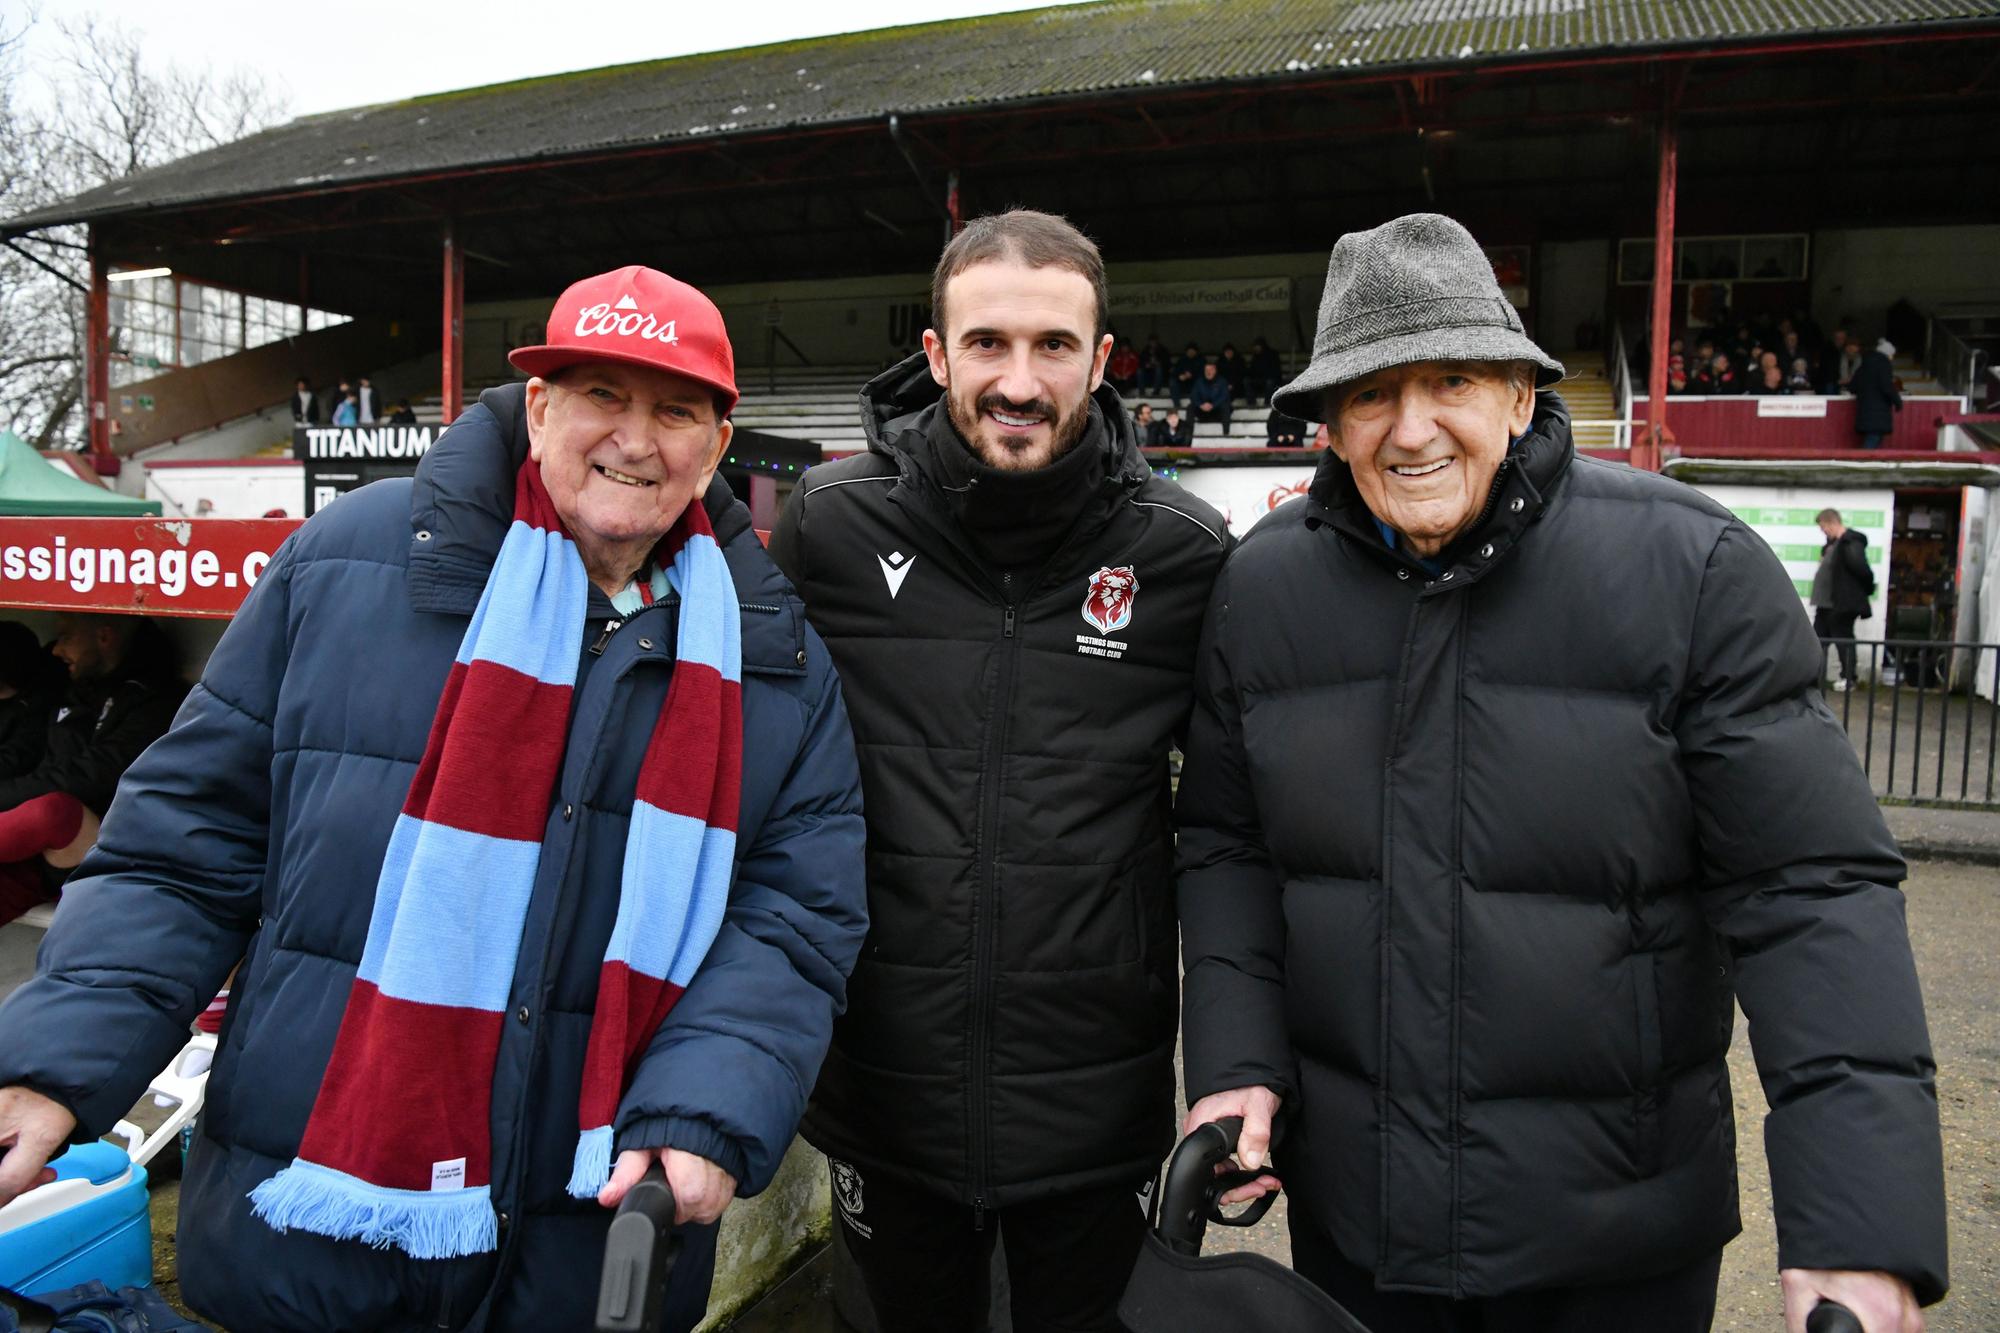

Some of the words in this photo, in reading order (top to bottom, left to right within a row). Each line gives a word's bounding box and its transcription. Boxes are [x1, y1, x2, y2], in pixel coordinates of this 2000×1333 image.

[1110, 290, 1146, 308] tings
[1149, 290, 1195, 304] United
[1197, 287, 1253, 303] Football
[1255, 286, 1289, 301] Club
[575, 303, 678, 343] Coors
[306, 427, 431, 457] TITANIUM
[0, 536, 270, 596] ssignage.c
[1076, 635, 1106, 647] HASTINGS
[1107, 640, 1127, 650] UNITED
[1078, 645, 1106, 656] FOOTBALL
[1107, 650, 1122, 658] CLUB
